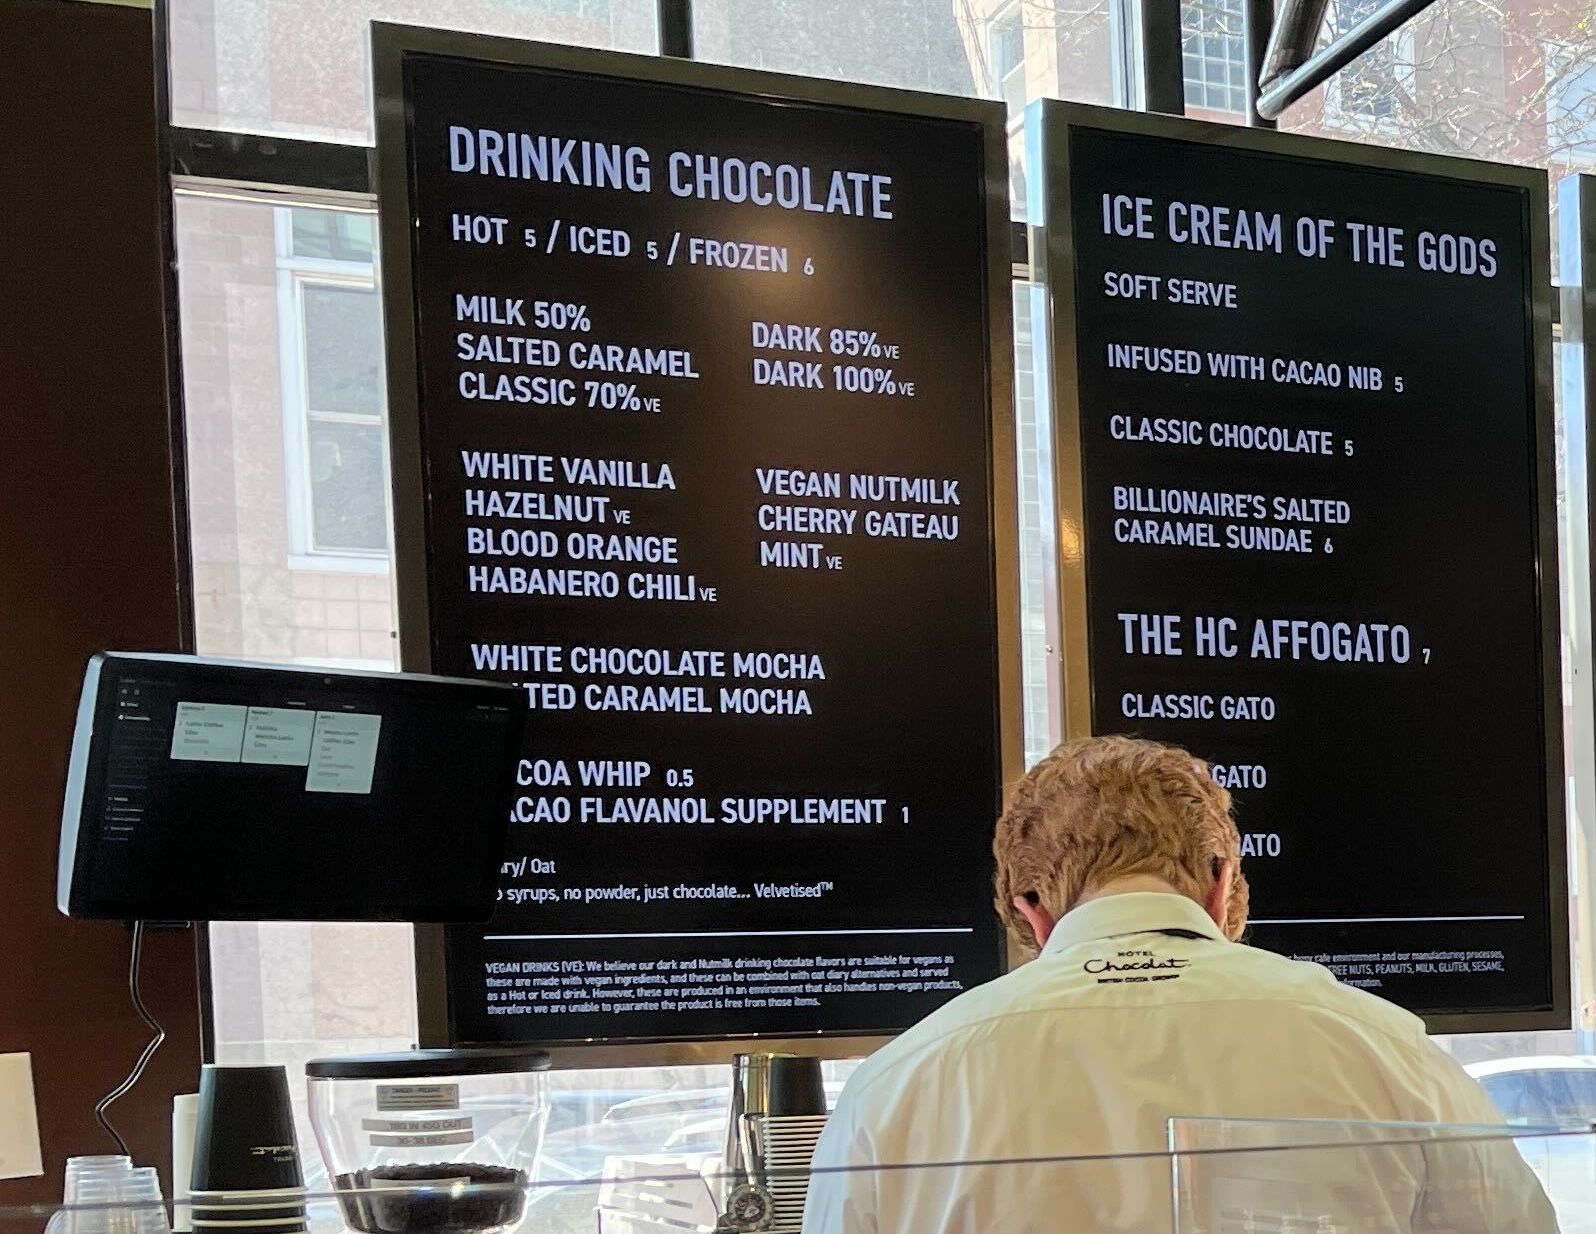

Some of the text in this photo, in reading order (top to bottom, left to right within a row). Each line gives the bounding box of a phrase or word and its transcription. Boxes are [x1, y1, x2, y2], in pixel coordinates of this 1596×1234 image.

[449, 125, 893, 220] DRINKING CHOCOLATE
[452, 213, 815, 277] HOT 5 ICED 5 FROZEN 6
[1102, 193, 1497, 278] ICE CREAM OF THE GODS
[1103, 271, 1238, 309] SOFT SERVE
[455, 293, 591, 332] MILK 50%
[751, 321, 823, 353] DARK
[457, 332, 700, 379] SALTED CARAMEL
[753, 358, 825, 389] DARK
[1107, 343, 1404, 393] INFUSED WITH CACAO NIB 5
[459, 371, 577, 407] CLASSIC
[1110, 414, 1354, 457] CLASSIC CHOCOLATE 5
[461, 450, 677, 490] WHITE VANILLA
[755, 467, 961, 506] VEGAN NUTMILK
[465, 489, 611, 524] HAZELNUT
[758, 504, 959, 541] CHERRY GATEAU
[1272, 496, 1351, 524] SALTED
[467, 528, 679, 564] BLOOD ORANGE
[1114, 518, 1334, 554] CARAMEL SUNDAE 6
[468, 566, 696, 601] HABANERO CHILI
[1117, 613, 1431, 665] THE HC AFFOGATO 7
[470, 643, 826, 680] WHITE CHOCOLATE MOCHA
[584, 684, 813, 715] CARAMEL MOCHA
[1121, 693, 1276, 721] CLASSIC GATO
[517, 759, 694, 788] COA WHIP 0.5
[580, 797, 909, 825] FLAVANOL SUPPLEMENT 1
[530, 858, 557, 874] Oat
[506, 888, 560, 905] syrups,
[585, 883, 641, 904] powder,
[643, 883, 670, 903] just
[484, 960, 638, 974] VEGAN DRINKS believe
